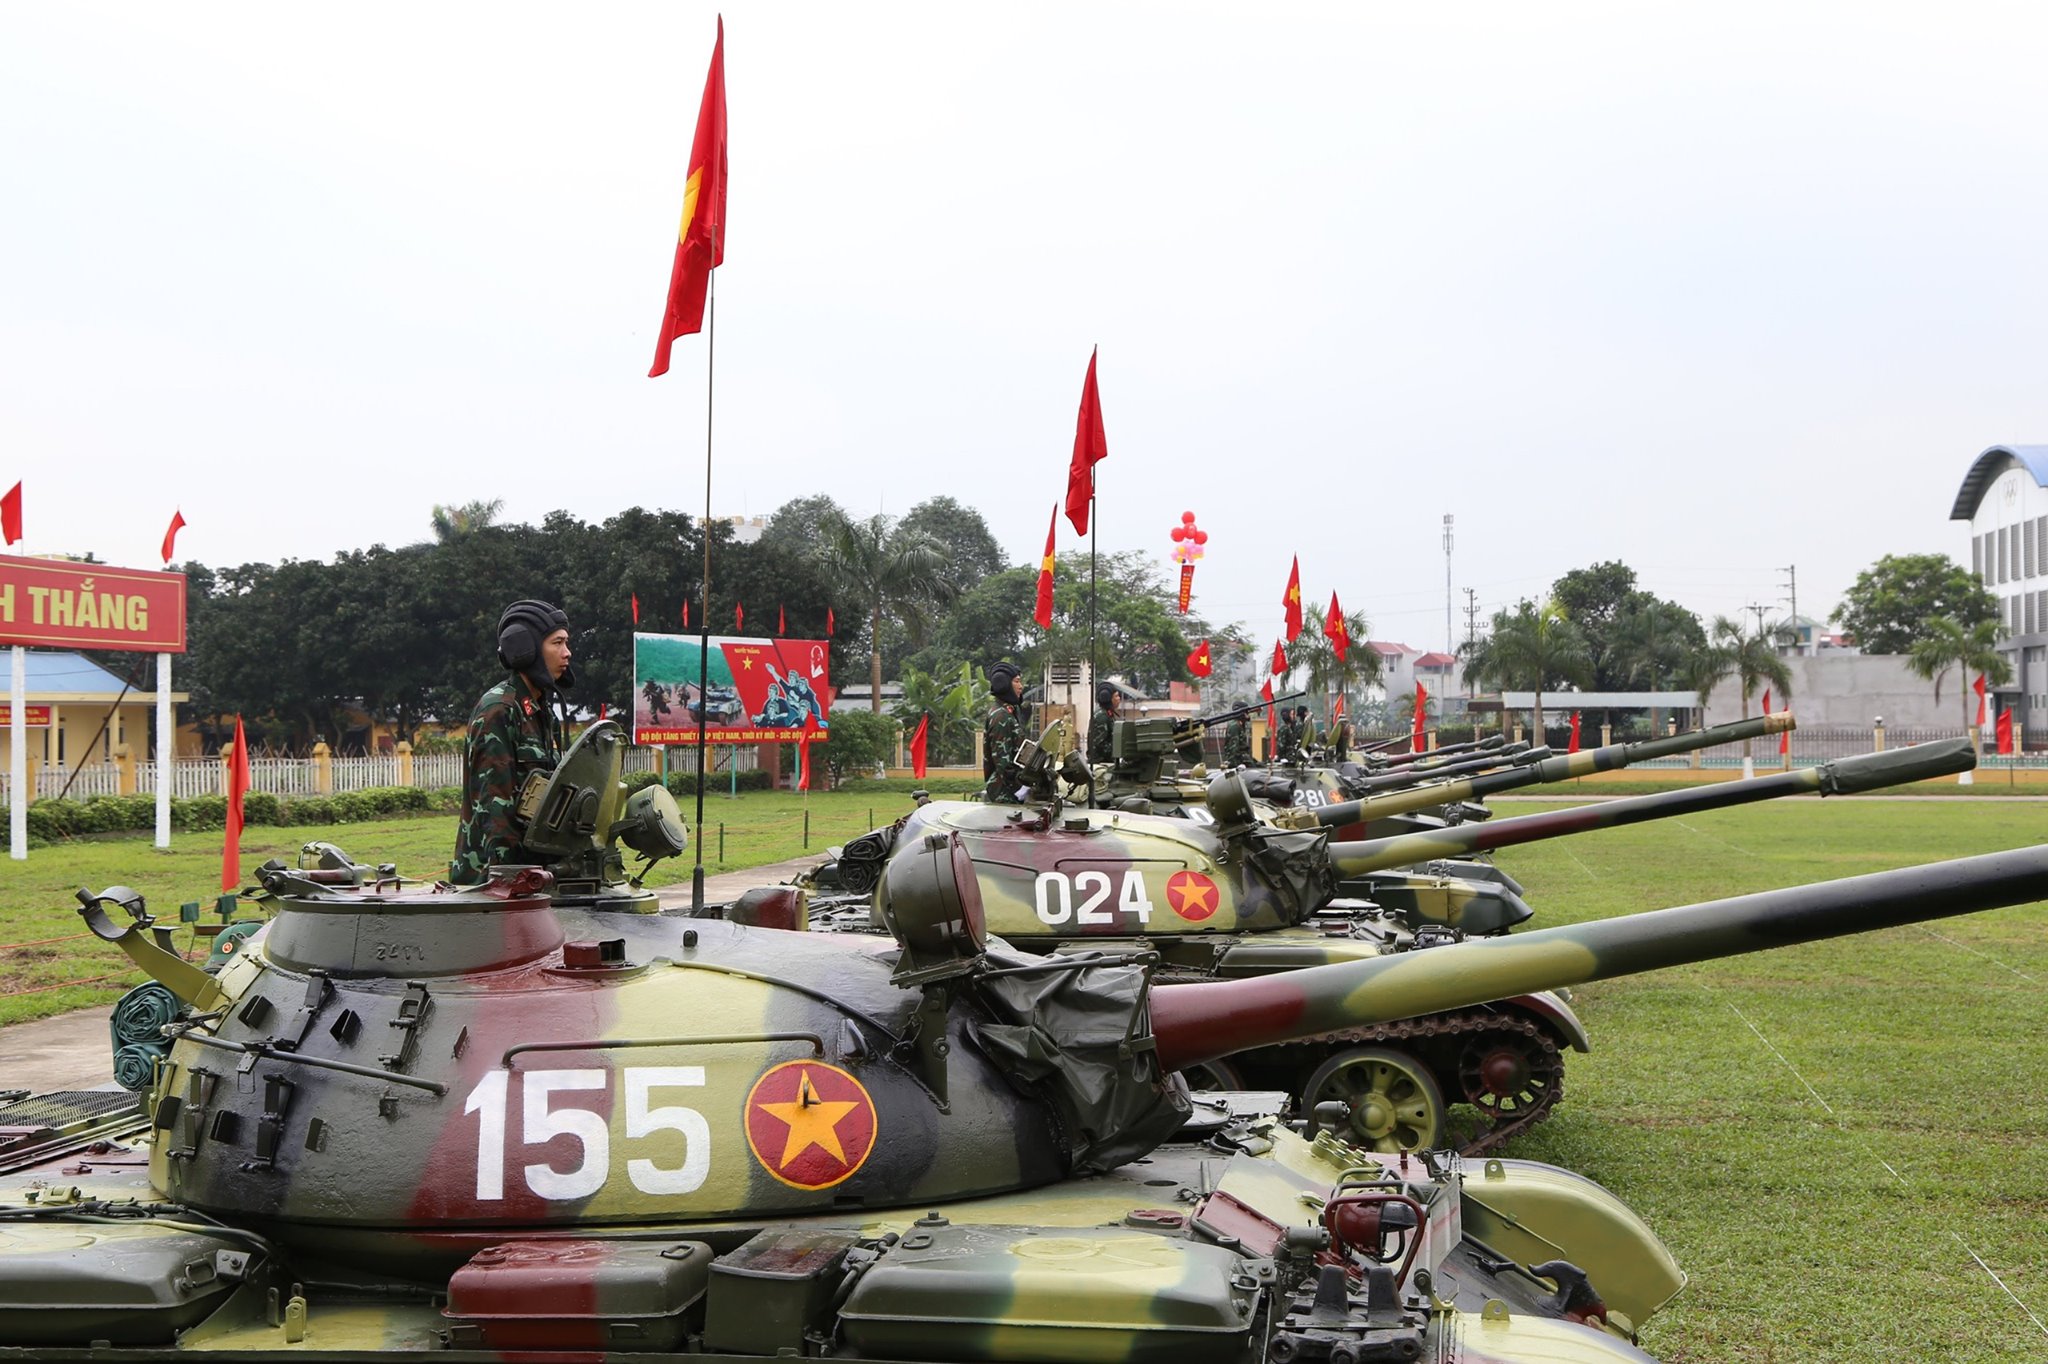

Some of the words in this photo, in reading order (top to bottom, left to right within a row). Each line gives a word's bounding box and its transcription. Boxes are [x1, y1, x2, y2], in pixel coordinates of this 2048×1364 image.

[27, 578, 148, 631] THẮNG
[1293, 789, 1327, 806] 281
[1035, 871, 1153, 925] 024
[464, 1066, 711, 1200] 155
